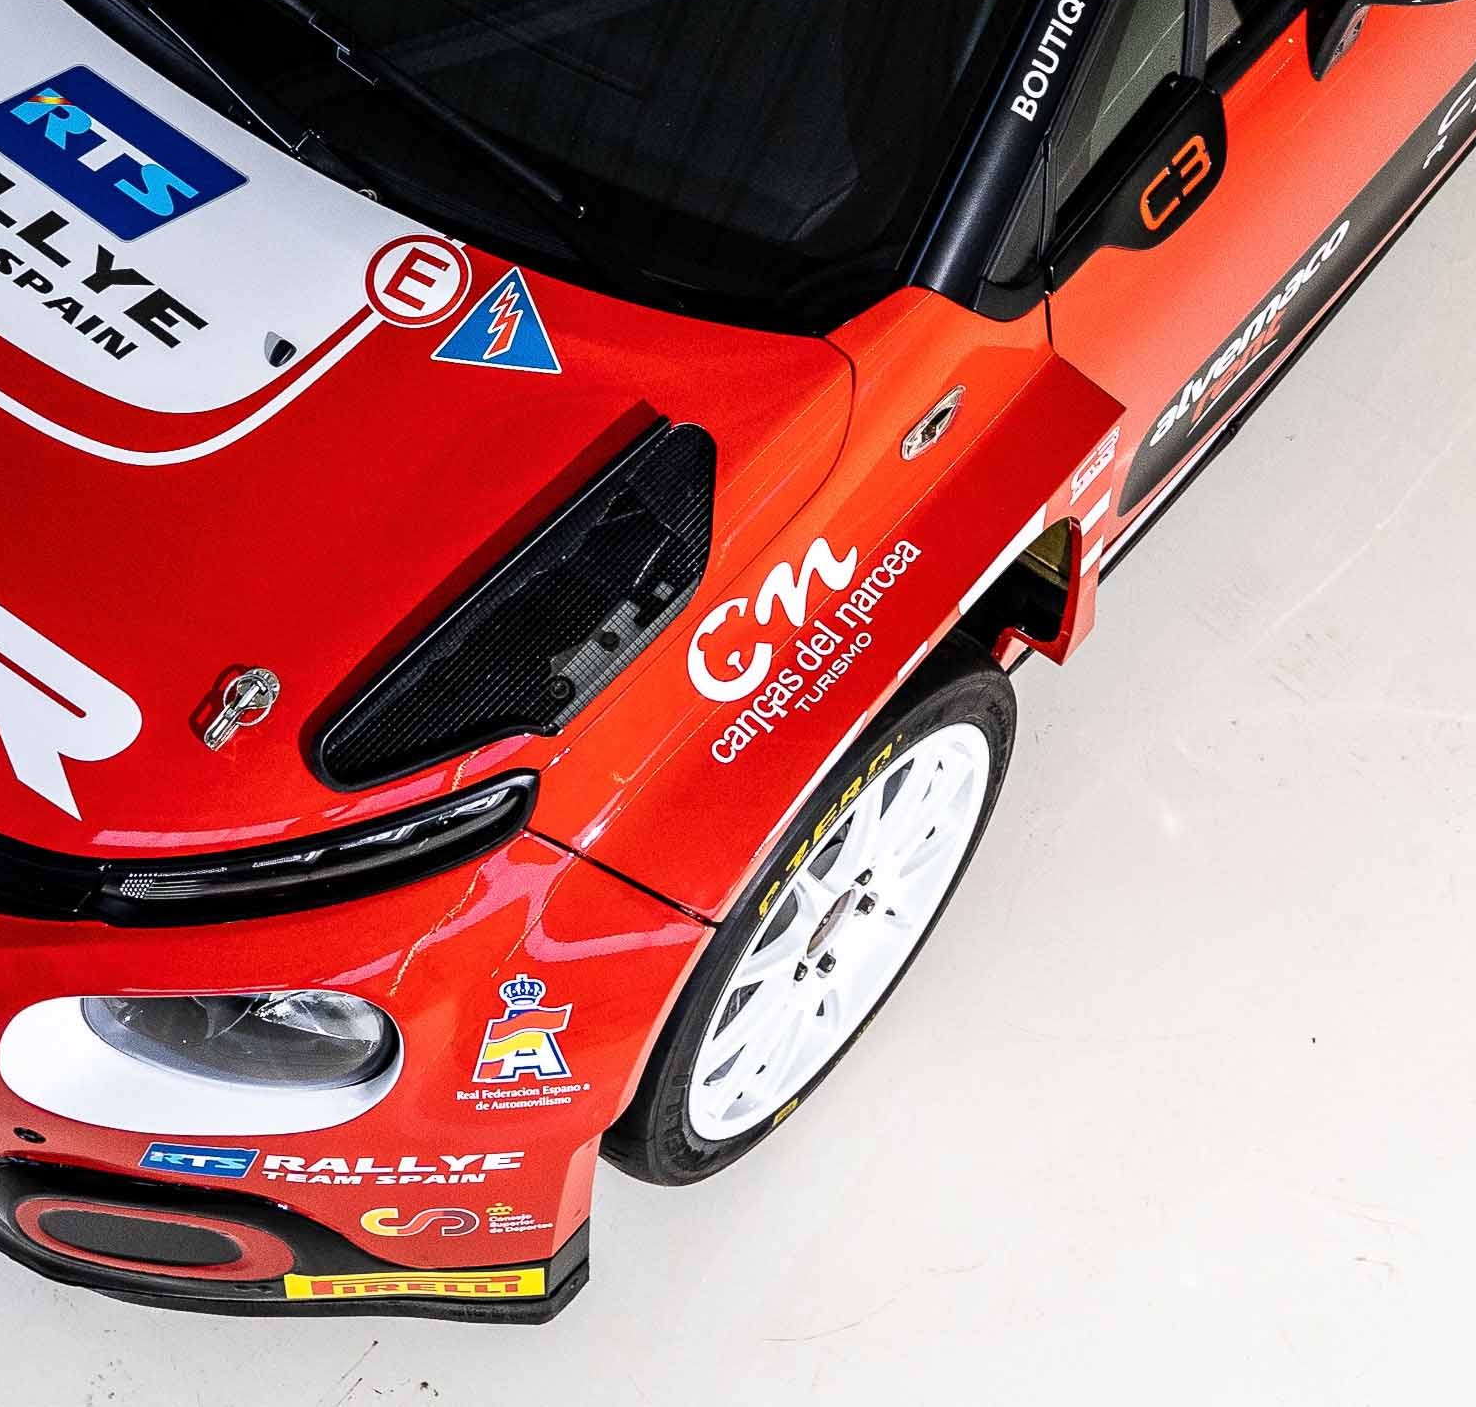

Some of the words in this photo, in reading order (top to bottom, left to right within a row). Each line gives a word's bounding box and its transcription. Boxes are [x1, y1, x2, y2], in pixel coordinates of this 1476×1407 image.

[9, 86, 199, 217] RTS
[1138, 135, 1210, 233] C3
[388, 252, 452, 311] E
[1150, 220, 1350, 446] alvemaco
[795, 619, 844, 672] del
[835, 540, 922, 629] narcea
[793, 631, 872, 712] TURISMO
[456, 1089, 480, 1101] Real
[475, 1102, 490, 1111] de
[491, 1096, 572, 1110] Automovilismo
[149, 1151, 247, 1171] RTS
[263, 1151, 525, 1173] RALLYE
[263, 1171, 362, 1185] TEAM
[374, 1171, 486, 1185] SPAIN
[311, 1274, 522, 1296] PIRELLI
